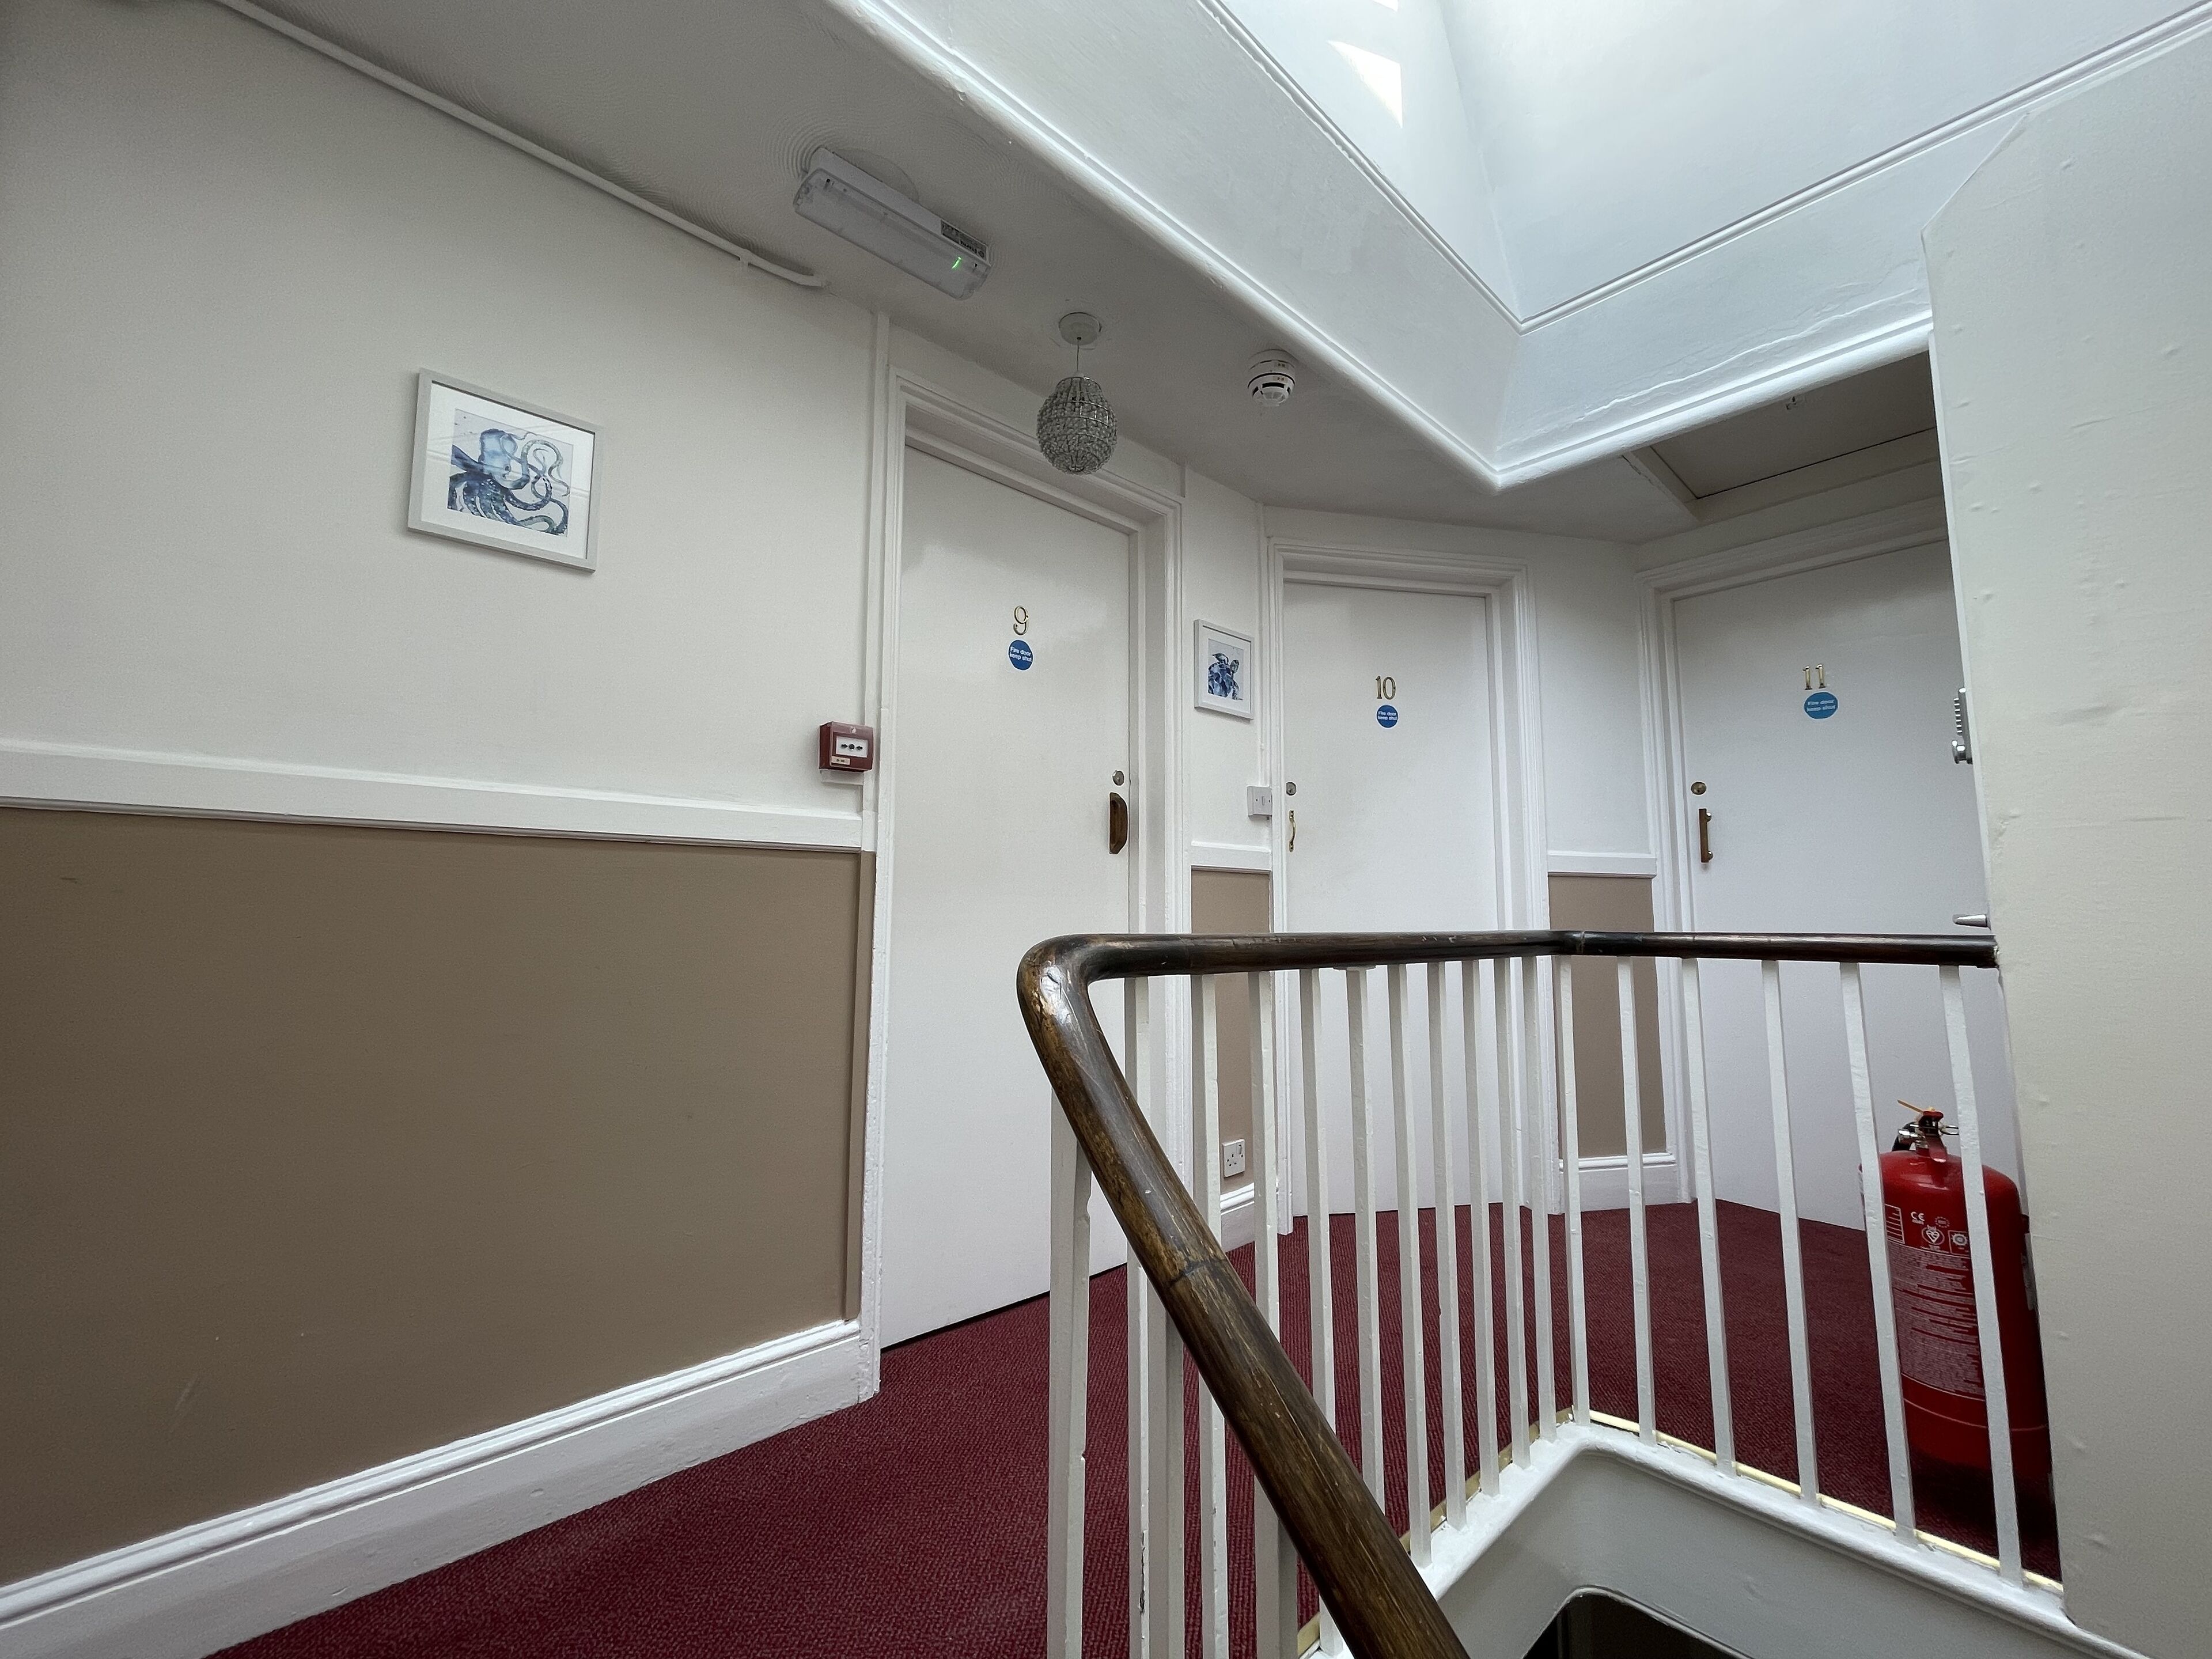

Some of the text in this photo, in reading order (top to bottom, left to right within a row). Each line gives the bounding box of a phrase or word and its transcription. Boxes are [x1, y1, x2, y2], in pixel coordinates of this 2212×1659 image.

[1013, 605, 1029, 635] 9
[1376, 676, 1396, 700] 10
[1802, 664, 1826, 690] 11
[1911, 1211, 1925, 1222] CE
